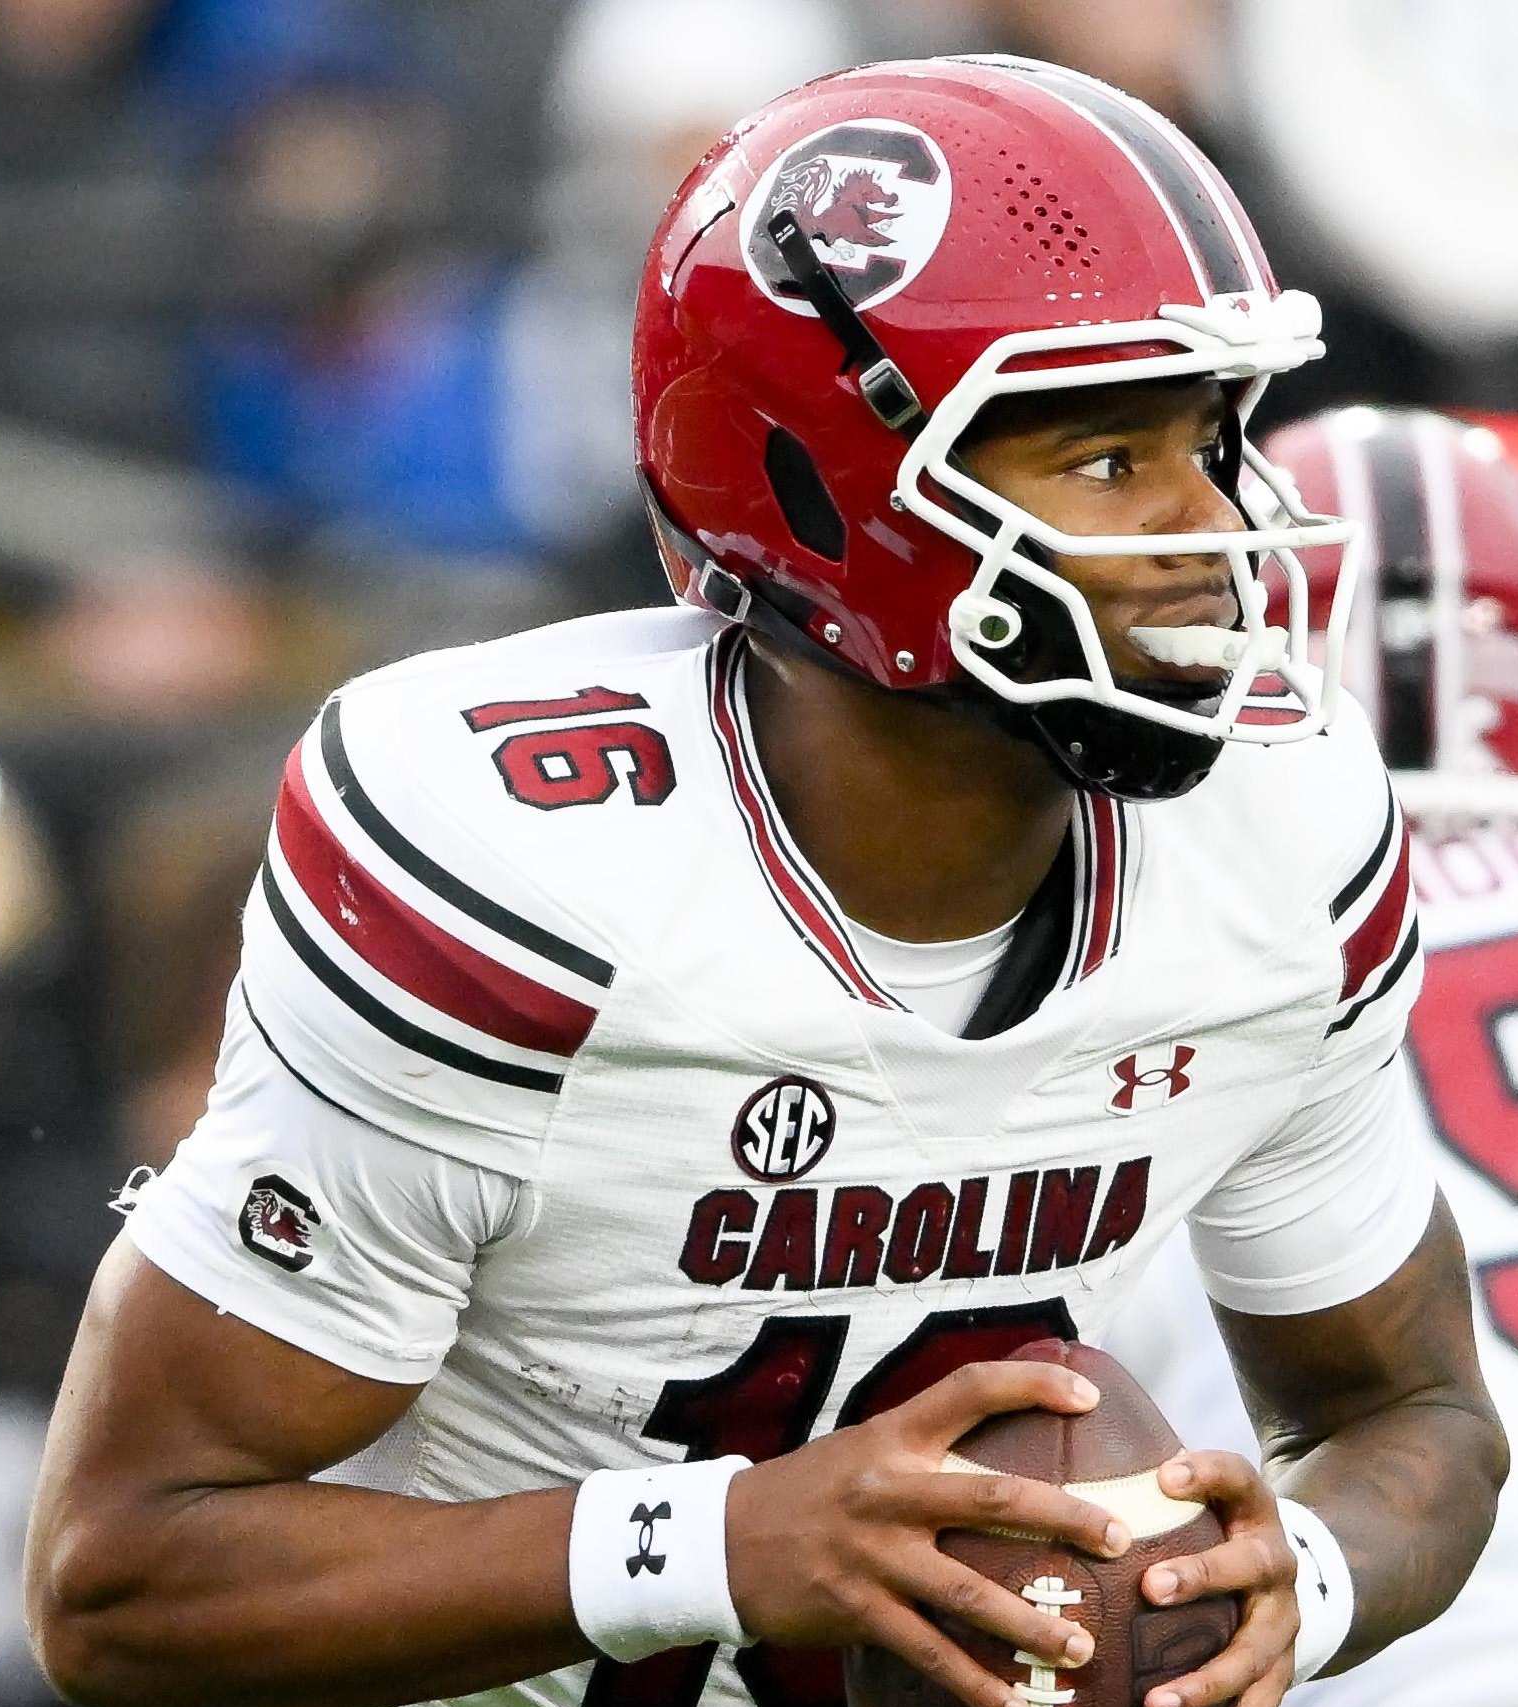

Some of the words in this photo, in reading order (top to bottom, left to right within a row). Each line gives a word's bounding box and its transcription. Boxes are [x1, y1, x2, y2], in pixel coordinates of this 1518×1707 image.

[459, 685, 677, 811] 16
[742, 1084, 829, 1175] SEC
[679, 1155, 1153, 1291] CAROLINA
